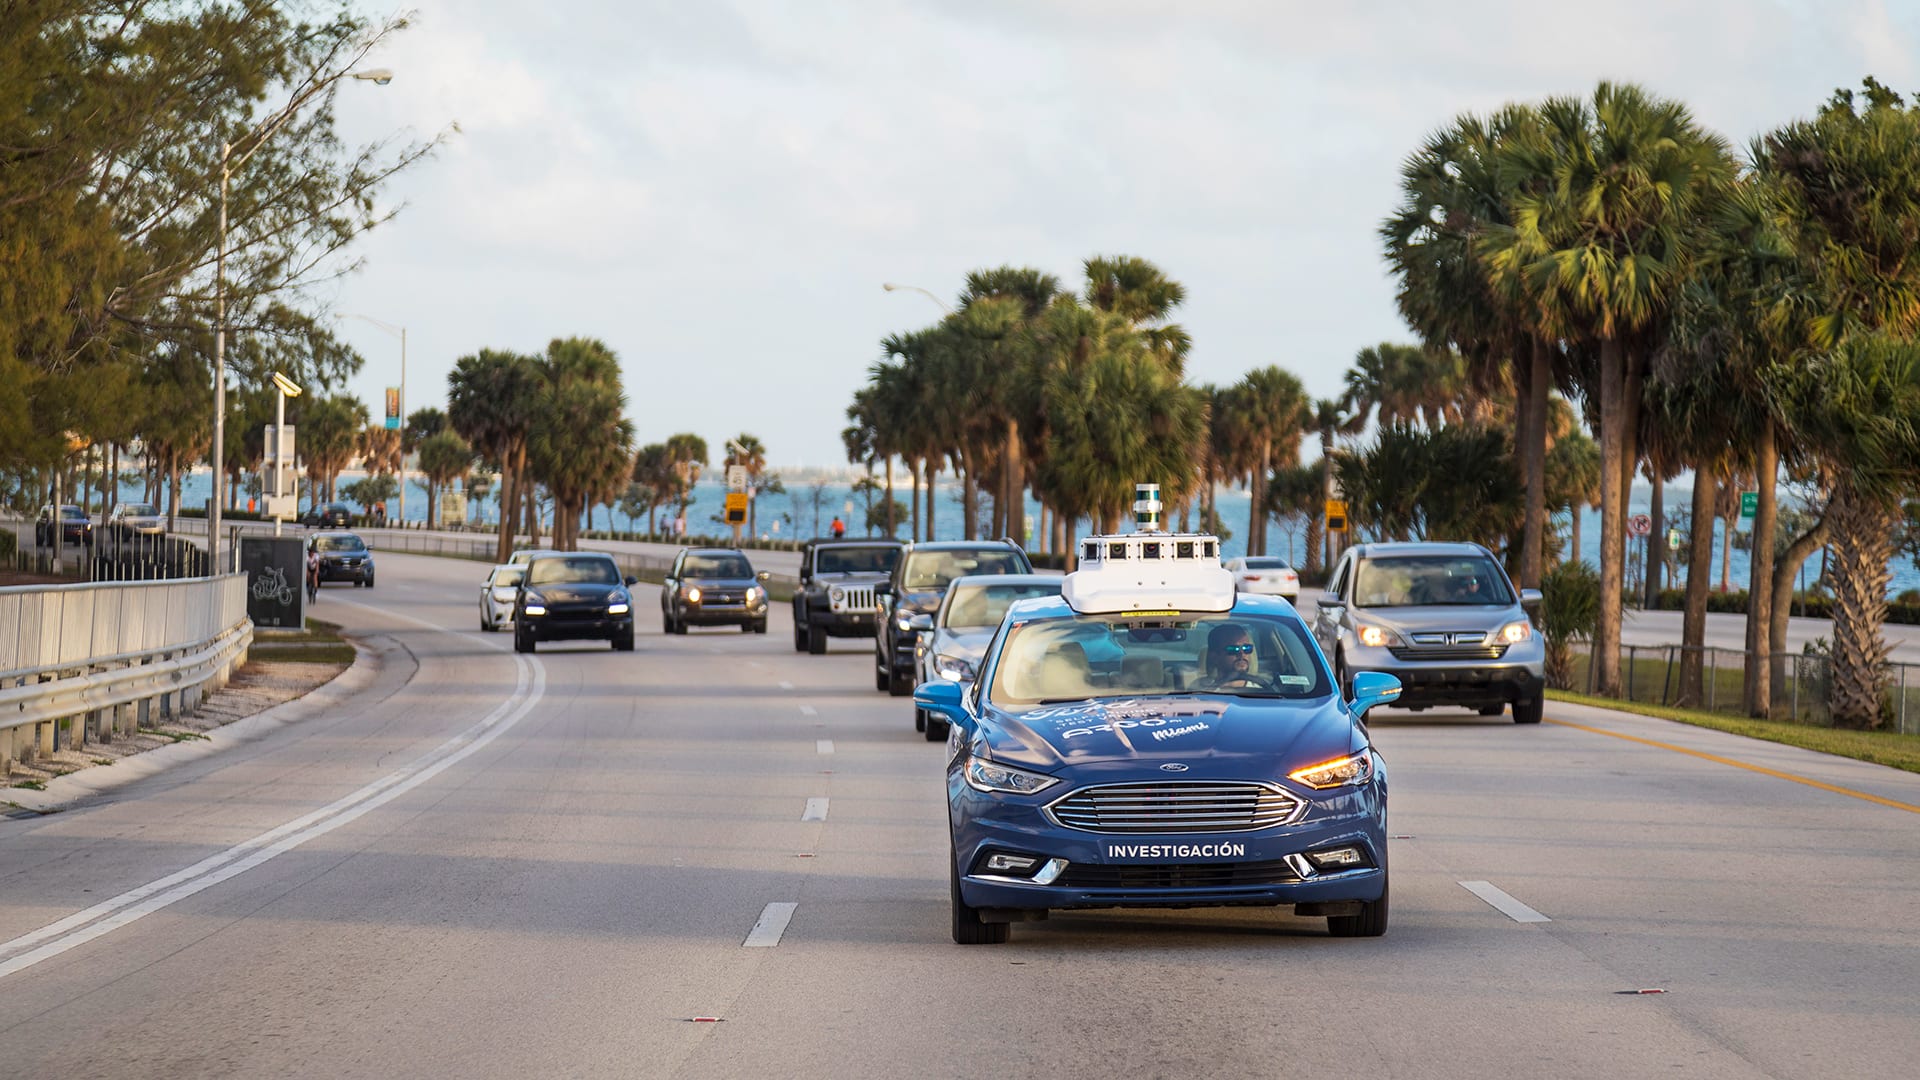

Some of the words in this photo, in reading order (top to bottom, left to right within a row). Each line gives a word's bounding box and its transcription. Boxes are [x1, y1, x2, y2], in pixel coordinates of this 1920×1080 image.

[1020, 699, 1138, 720] Ford
[1152, 722, 1209, 741] Miami
[1109, 841, 1245, 858] INVESTIGACIÓN
